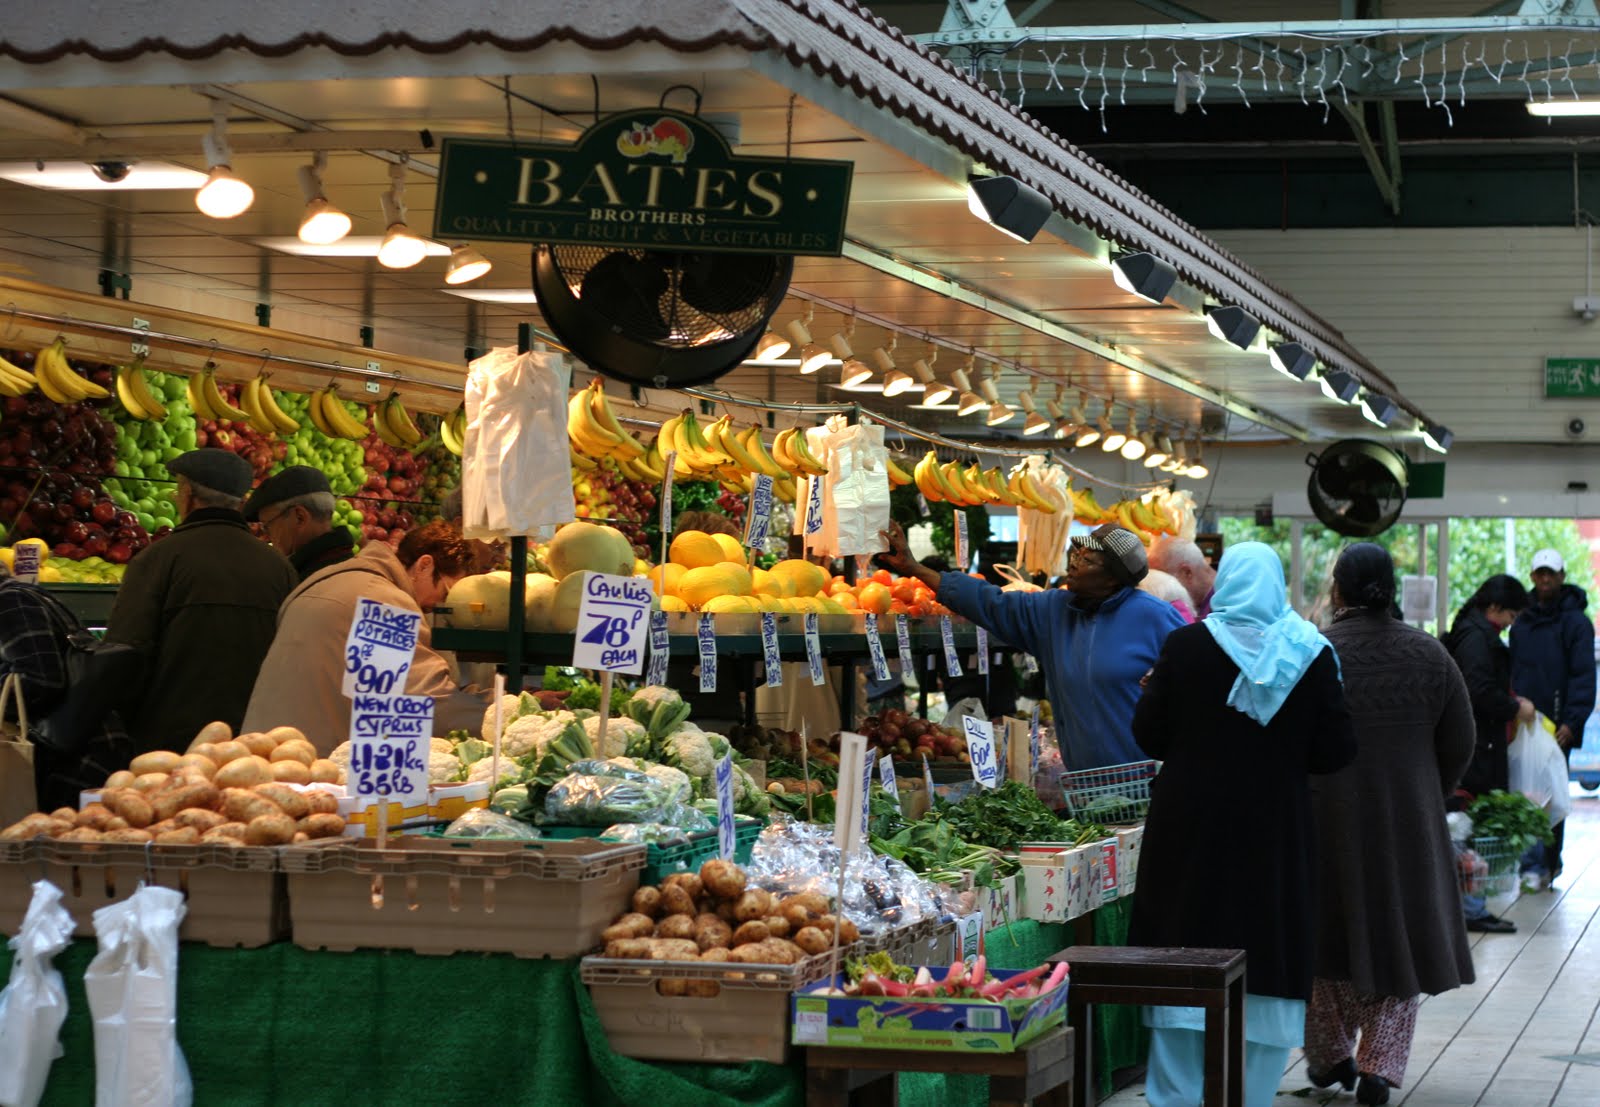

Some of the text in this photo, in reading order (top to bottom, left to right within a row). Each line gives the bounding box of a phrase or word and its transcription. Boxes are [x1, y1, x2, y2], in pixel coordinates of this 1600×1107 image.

[514, 156, 784, 218] BATES
[589, 207, 707, 226] BROTHERS
[452, 215, 563, 236] QUALITY
[572, 221, 643, 241] FRUIT
[681, 227, 827, 248] VEGETABLES
[361, 599, 422, 631] JACKET
[354, 619, 416, 649] POTATOES
[600, 649, 638, 666] EACH
[354, 695, 436, 716] NEW CROP
[354, 716, 424, 736] CYPRUS
